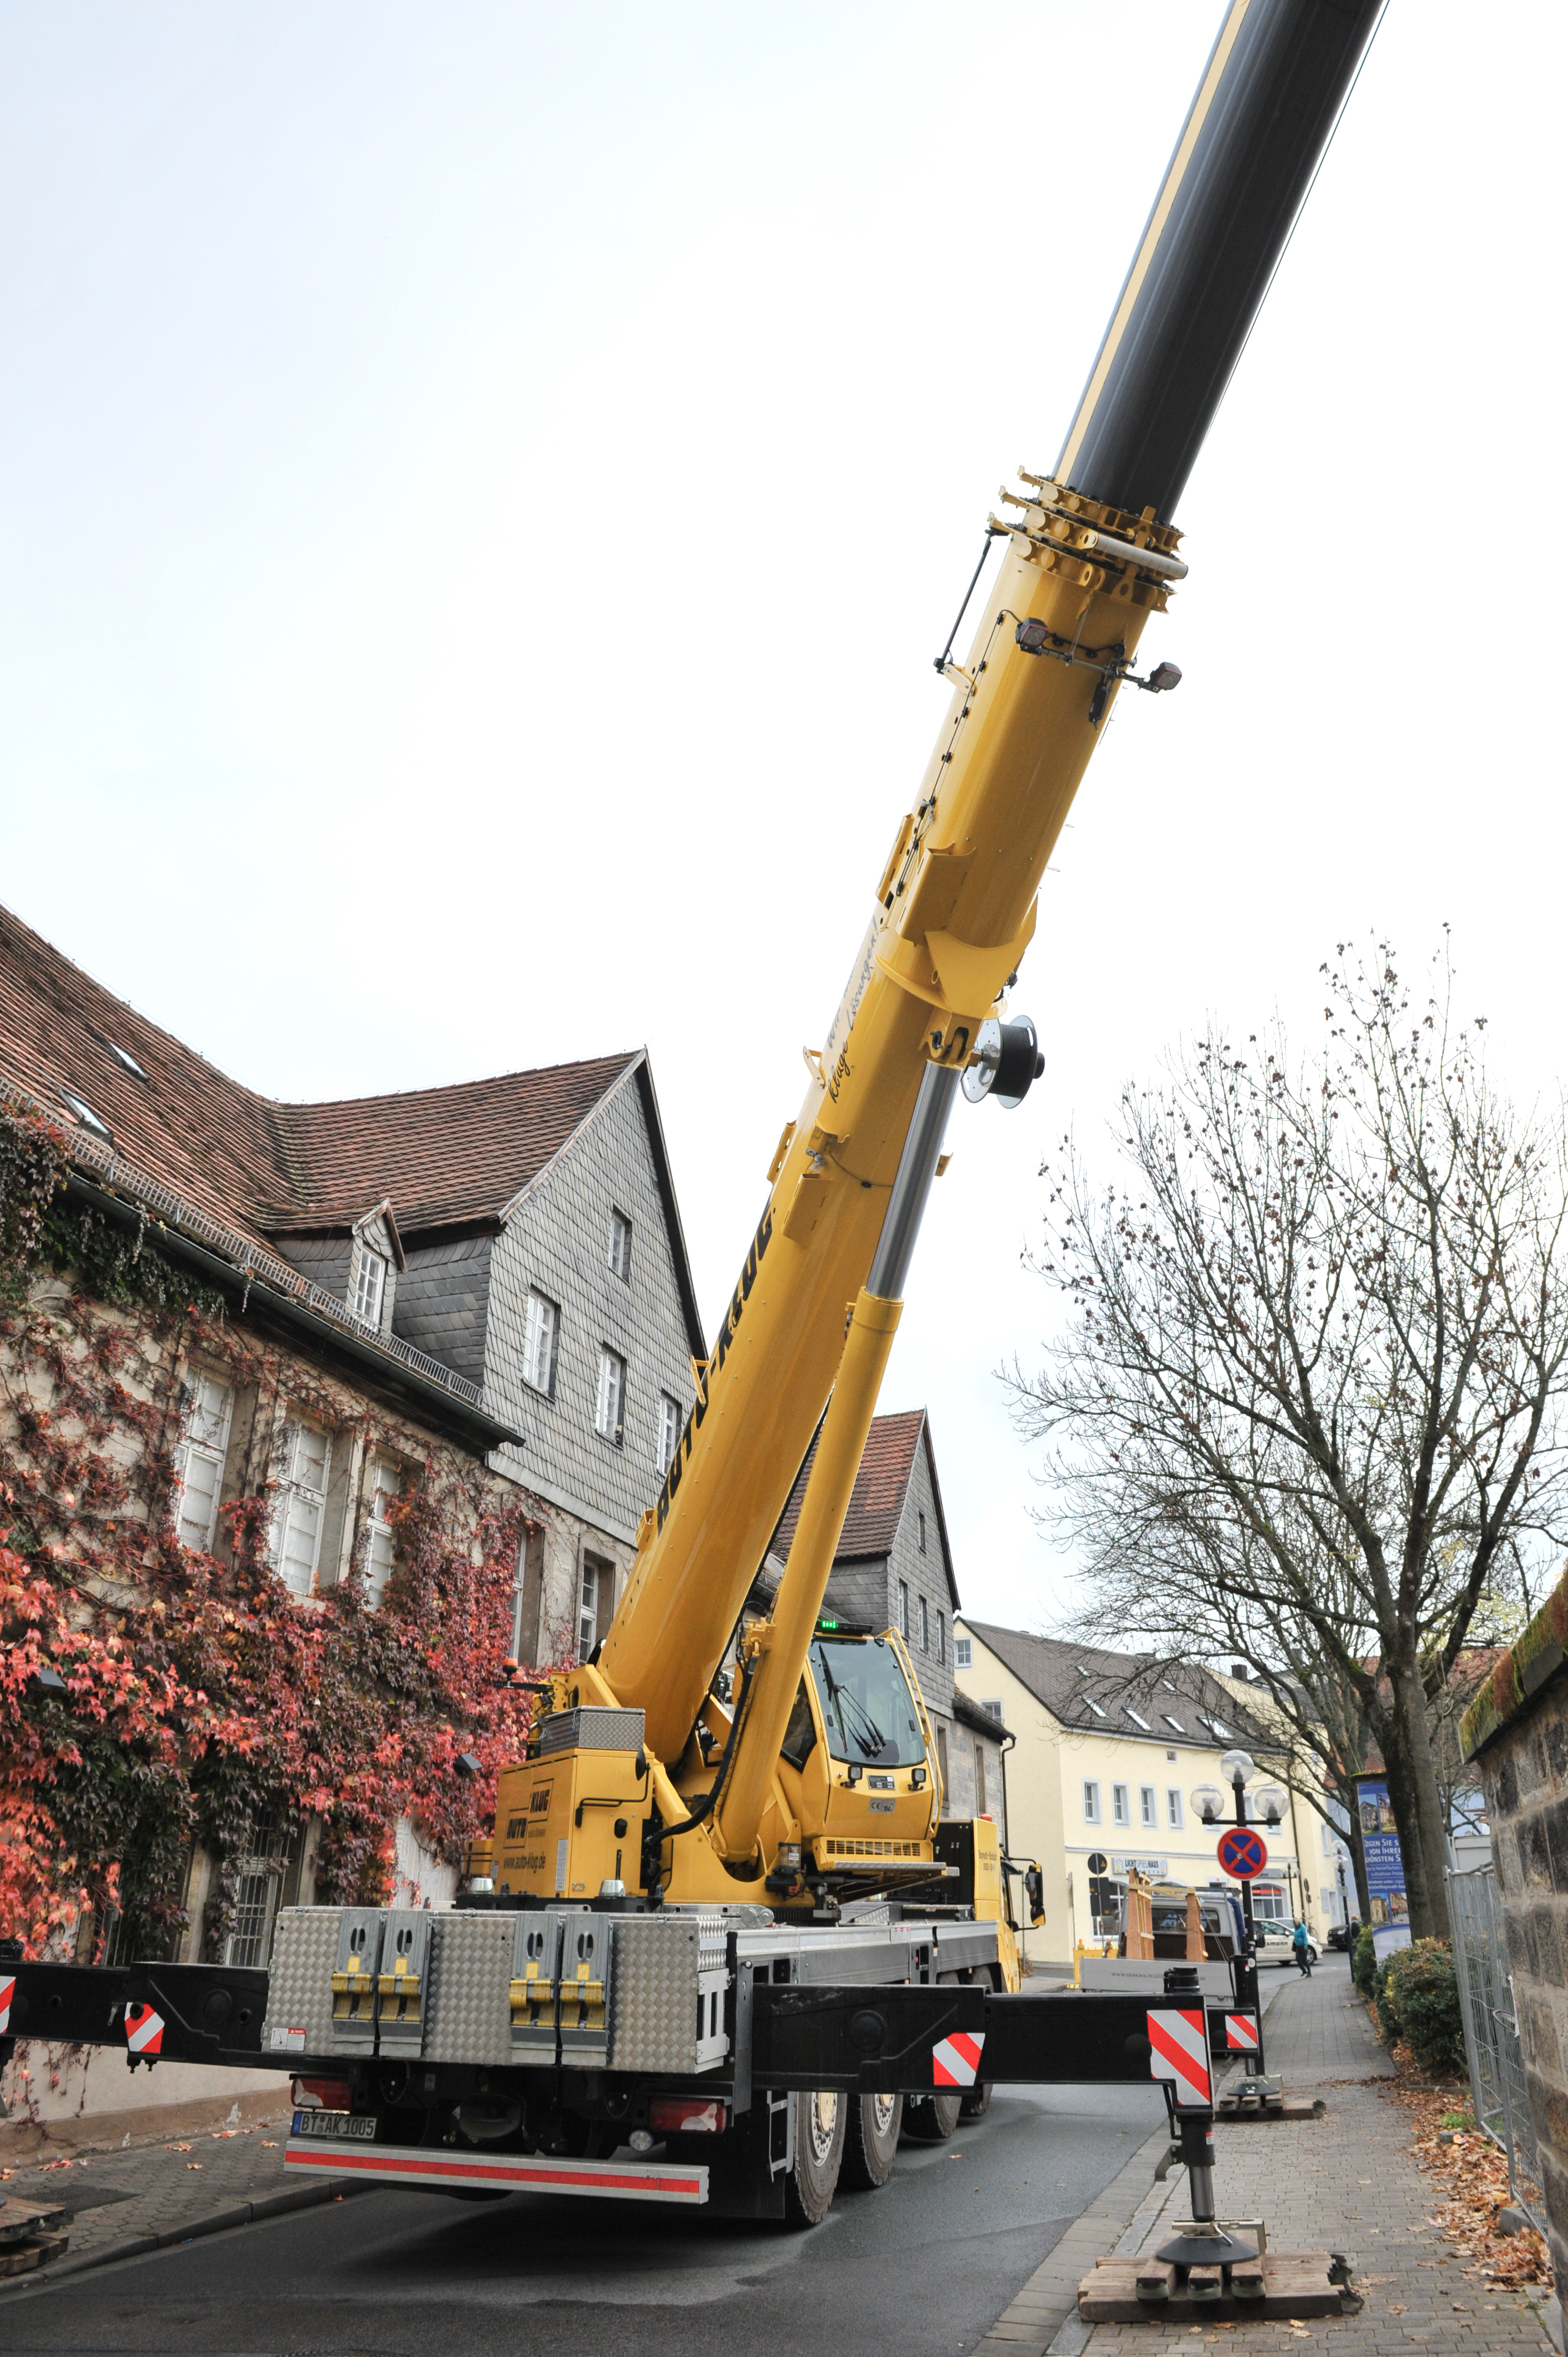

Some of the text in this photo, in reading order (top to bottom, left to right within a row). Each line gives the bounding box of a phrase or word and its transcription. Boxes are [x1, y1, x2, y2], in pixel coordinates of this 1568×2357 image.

[529, 1789, 550, 1813] KLUG
[507, 1818, 527, 1839] AUTO
[503, 1851, 546, 1874] www.auto-klug.de
[301, 2114, 374, 2137] BT AK 1005
